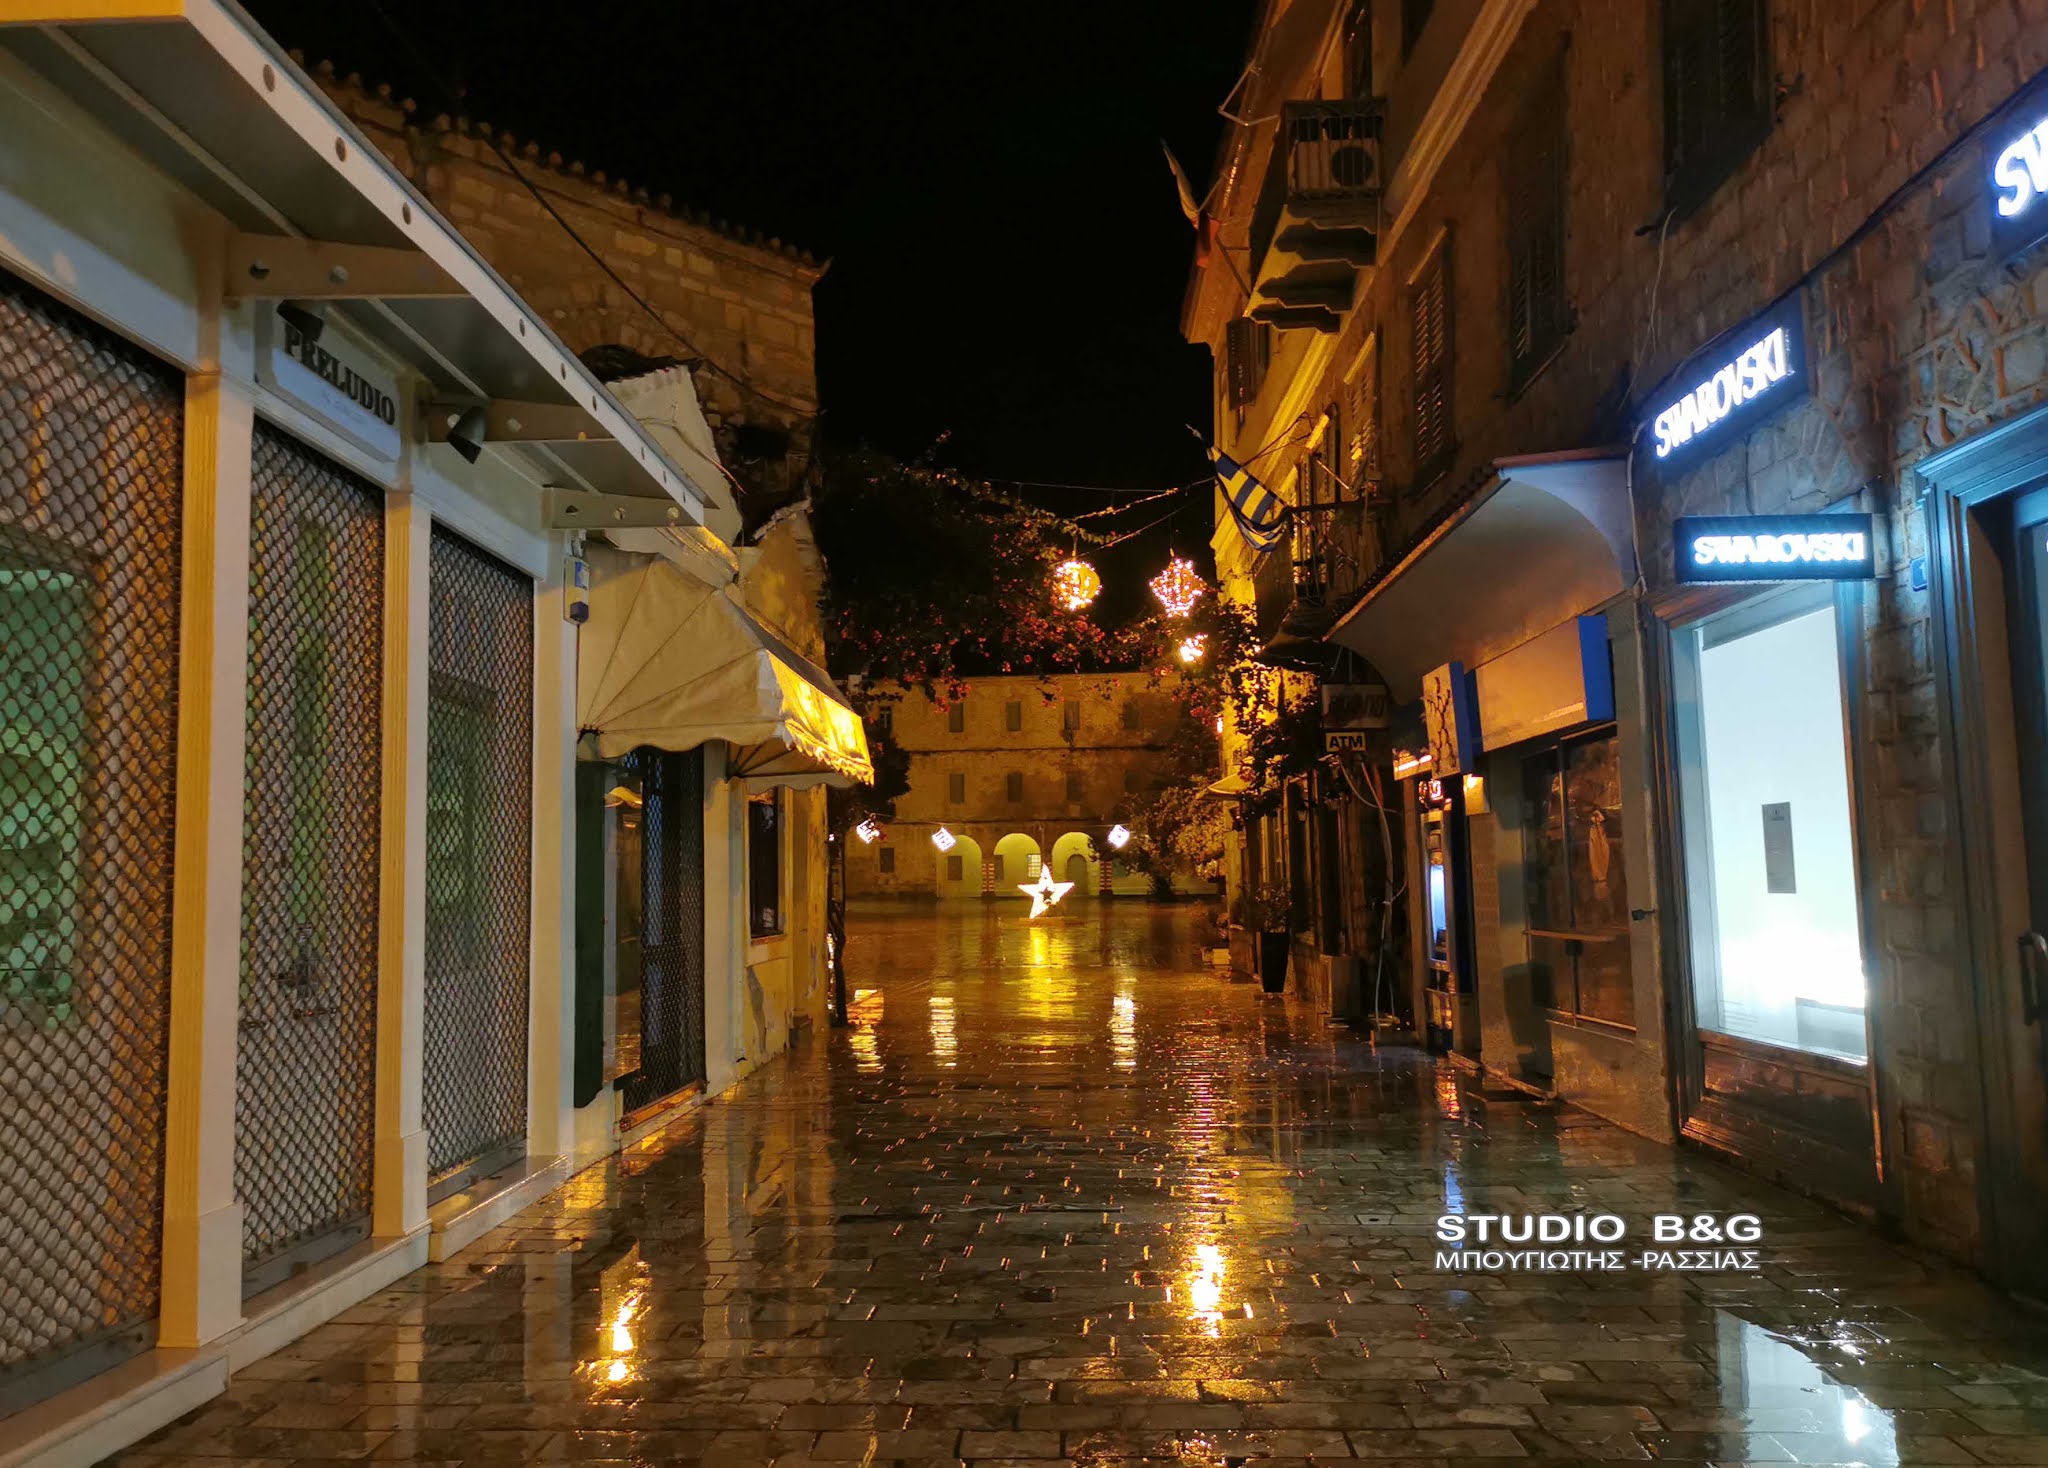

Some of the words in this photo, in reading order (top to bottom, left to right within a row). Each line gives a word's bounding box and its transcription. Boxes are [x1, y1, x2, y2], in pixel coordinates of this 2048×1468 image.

[285, 322, 395, 425] PRELUDIO
[1654, 327, 1787, 457] SWAROVSKI
[1693, 532, 1866, 564] SWAROVSKI
[1329, 735, 1363, 750] ATM
